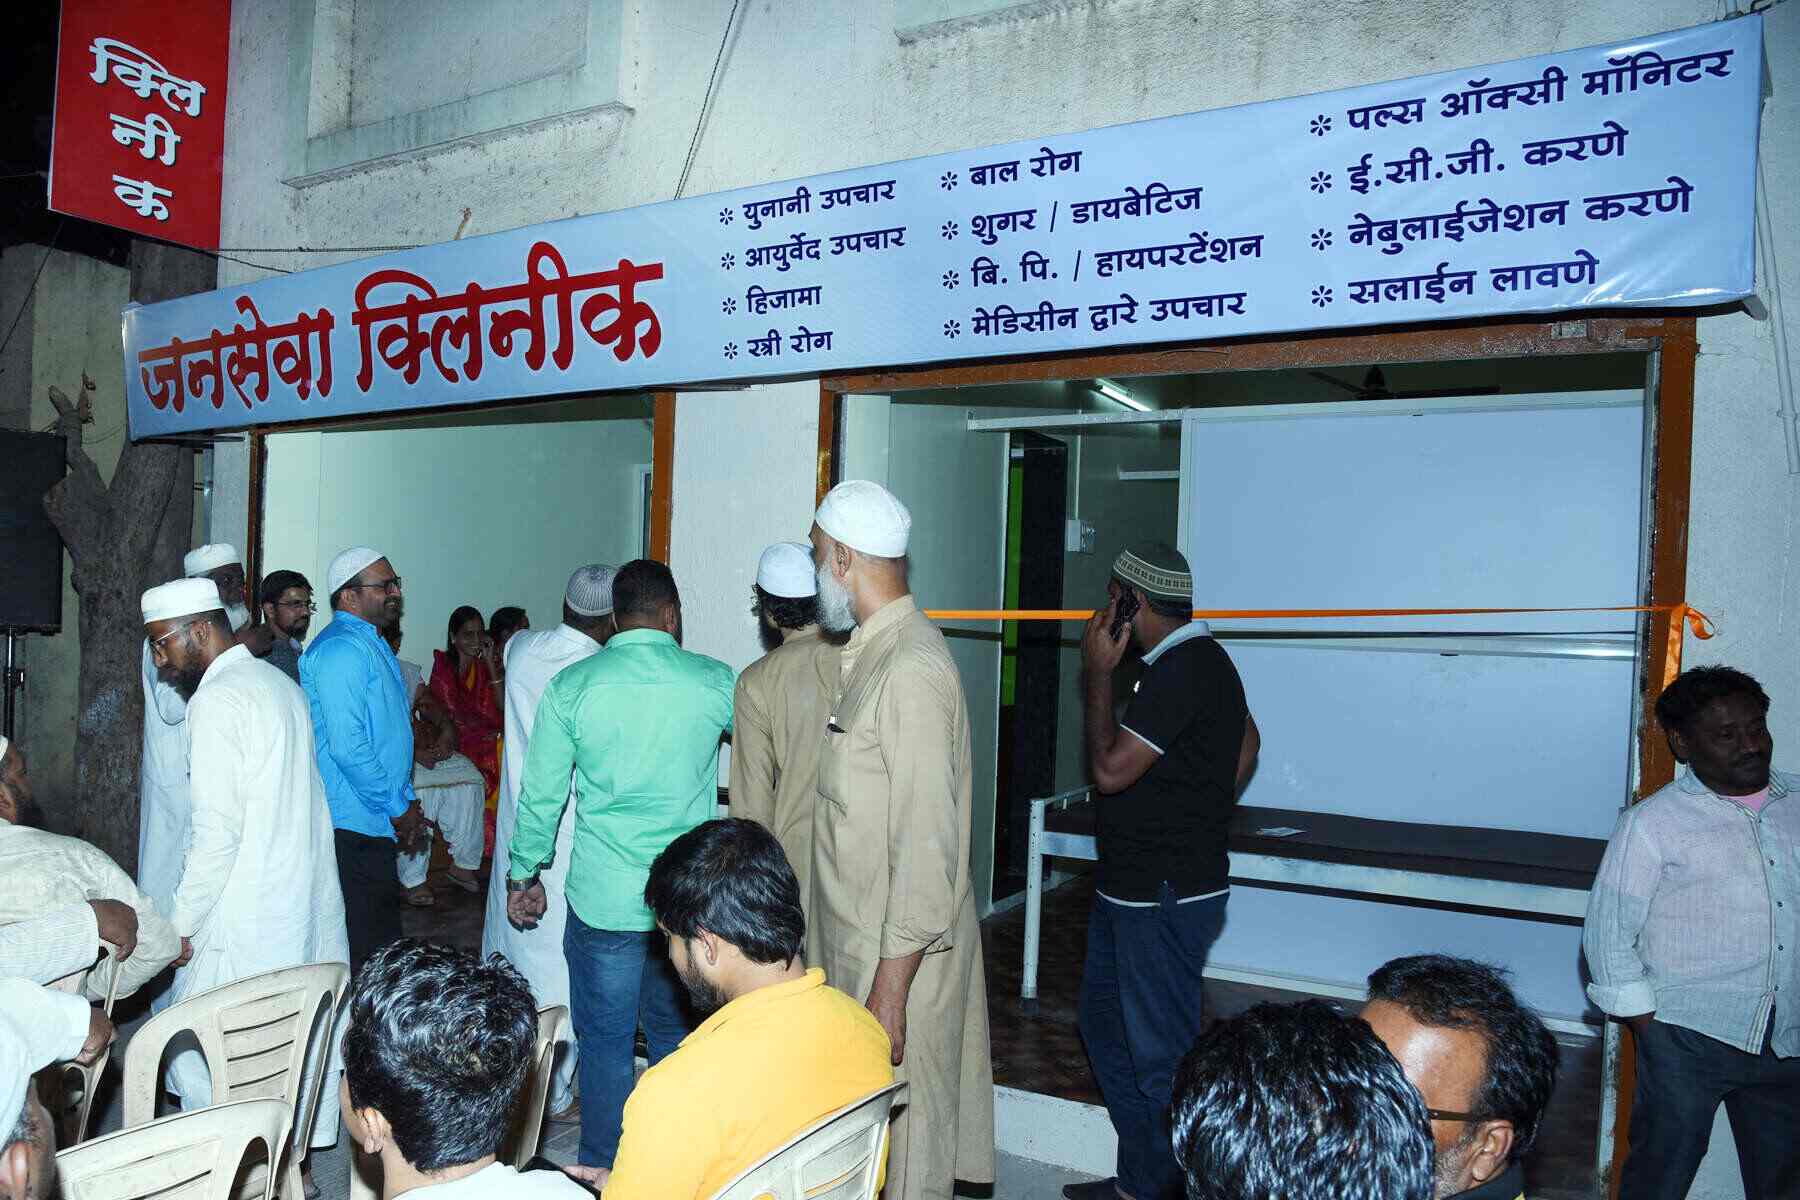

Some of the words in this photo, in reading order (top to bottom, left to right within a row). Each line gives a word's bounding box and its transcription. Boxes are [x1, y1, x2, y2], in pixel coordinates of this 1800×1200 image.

[1346, 97, 1426, 131] पल्स
[1440, 66, 1569, 118] ऑक्सी
[1582, 49, 1735, 96] मॉनिटर
[110, 113, 181, 166] नी
[1522, 121, 1630, 166] करणे
[969, 160, 1020, 187] बाल
[1030, 147, 1083, 178] रोग
[113, 174, 173, 221] क
[743, 187, 811, 230] युनानी
[819, 180, 897, 210] उपचार
[971, 209, 1038, 246] शुगर
[1071, 182, 1204, 224] डायबेटिज
[1347, 197, 1570, 256] नेबुलाईजेशन
[1583, 176, 1695, 222] करणे
[745, 233, 821, 272] आयुर्वेद
[830, 226, 907, 256] उपचार
[970, 256, 1008, 288] बि.
[1019, 250, 1058, 283] पि.
[1094, 230, 1265, 278] हायपरटेंशन
[745, 284, 822, 315] हिजामा
[1347, 262, 1478, 305] सलाईन
[1490, 249, 1600, 292] लावणे
[138, 296, 335, 410] जनसेवा
[352, 241, 664, 393] क्लिनीक
[972, 300, 1079, 337] मेडिसीन
[1089, 293, 1138, 332] द्वारे
[1149, 292, 1248, 322] उपचार
[746, 328, 782, 358] स्त्री
[789, 326, 834, 353] रोग
